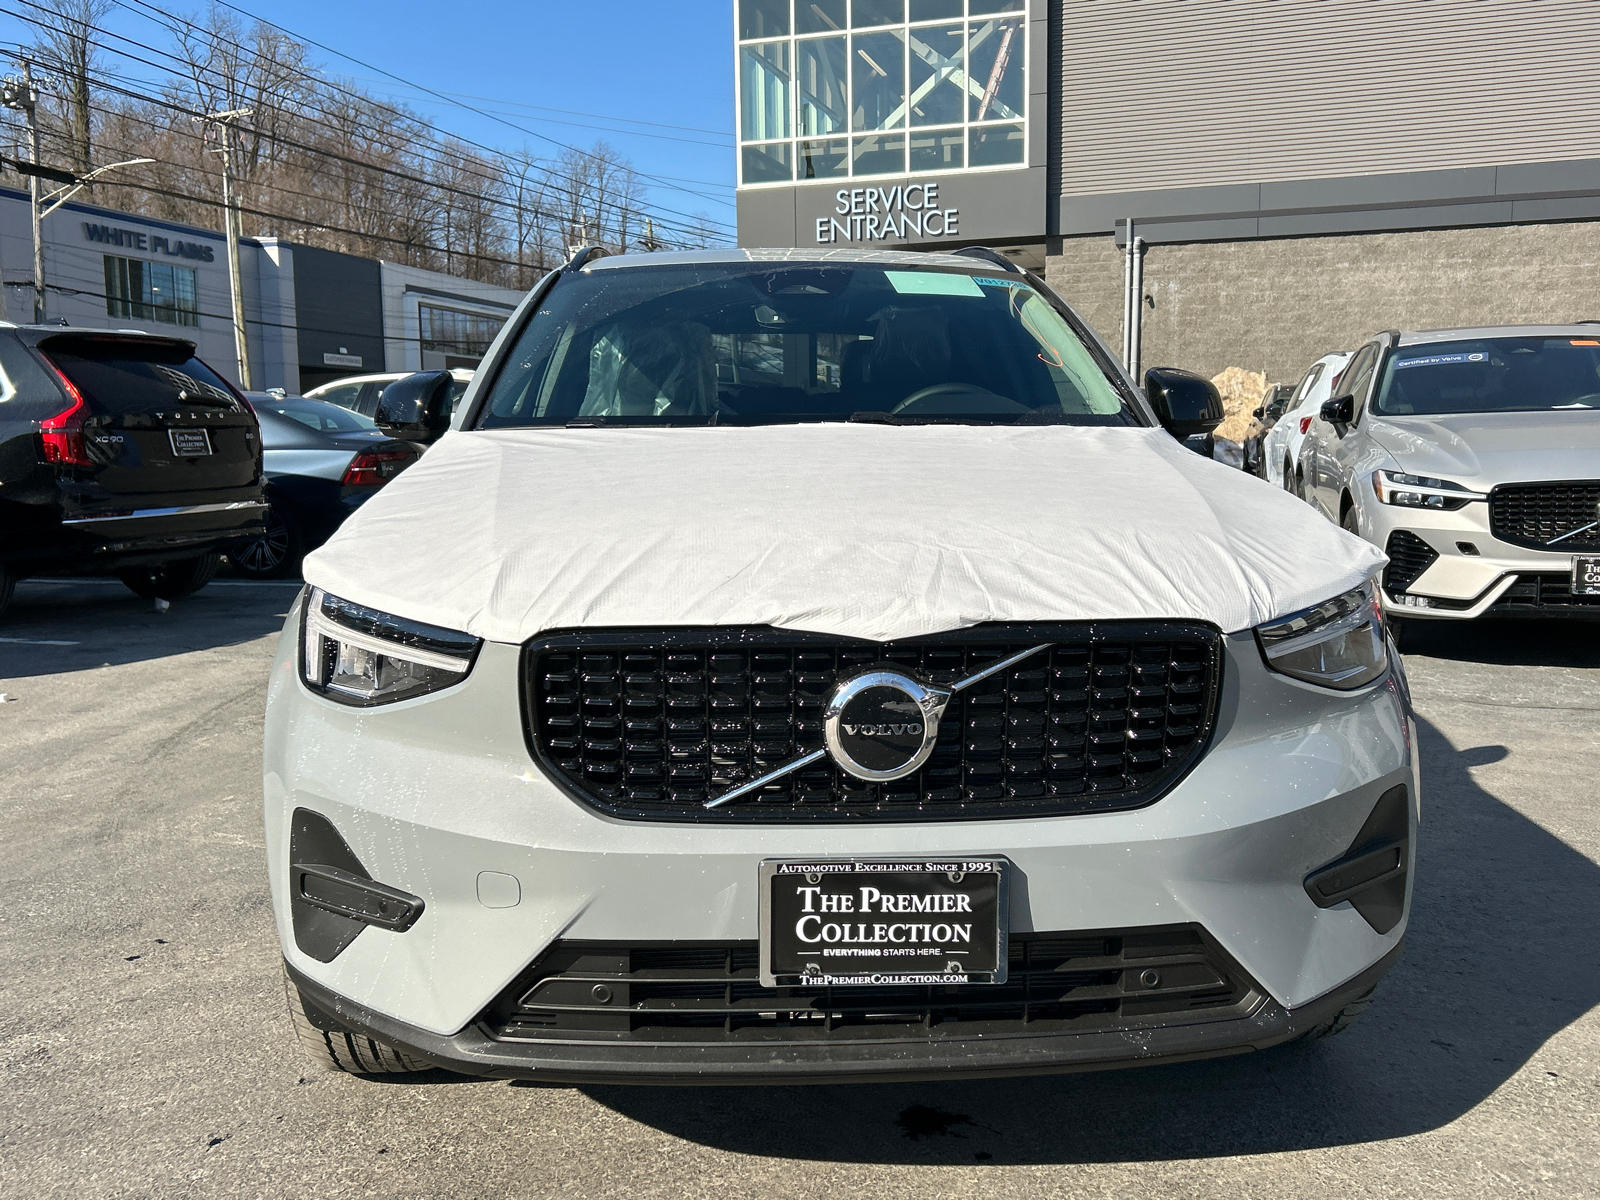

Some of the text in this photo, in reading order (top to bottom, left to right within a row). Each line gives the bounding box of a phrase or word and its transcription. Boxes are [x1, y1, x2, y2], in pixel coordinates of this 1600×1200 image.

[835, 183, 938, 215] SERVICE
[816, 209, 958, 242] ENTRANCE
[82, 222, 214, 262] WHITE PLAINS
[1398, 358, 1429, 367] Certified
[95, 435, 124, 443] XC90
[842, 723, 923, 736] VOLVO
[779, 862, 992, 873] AUTOMOTIVE EXCELLENCE SINCE 1995
[796, 886, 972, 913] THE PREMIER
[795, 915, 973, 943] COLLECTION
[917, 948, 943, 956] HERE.
